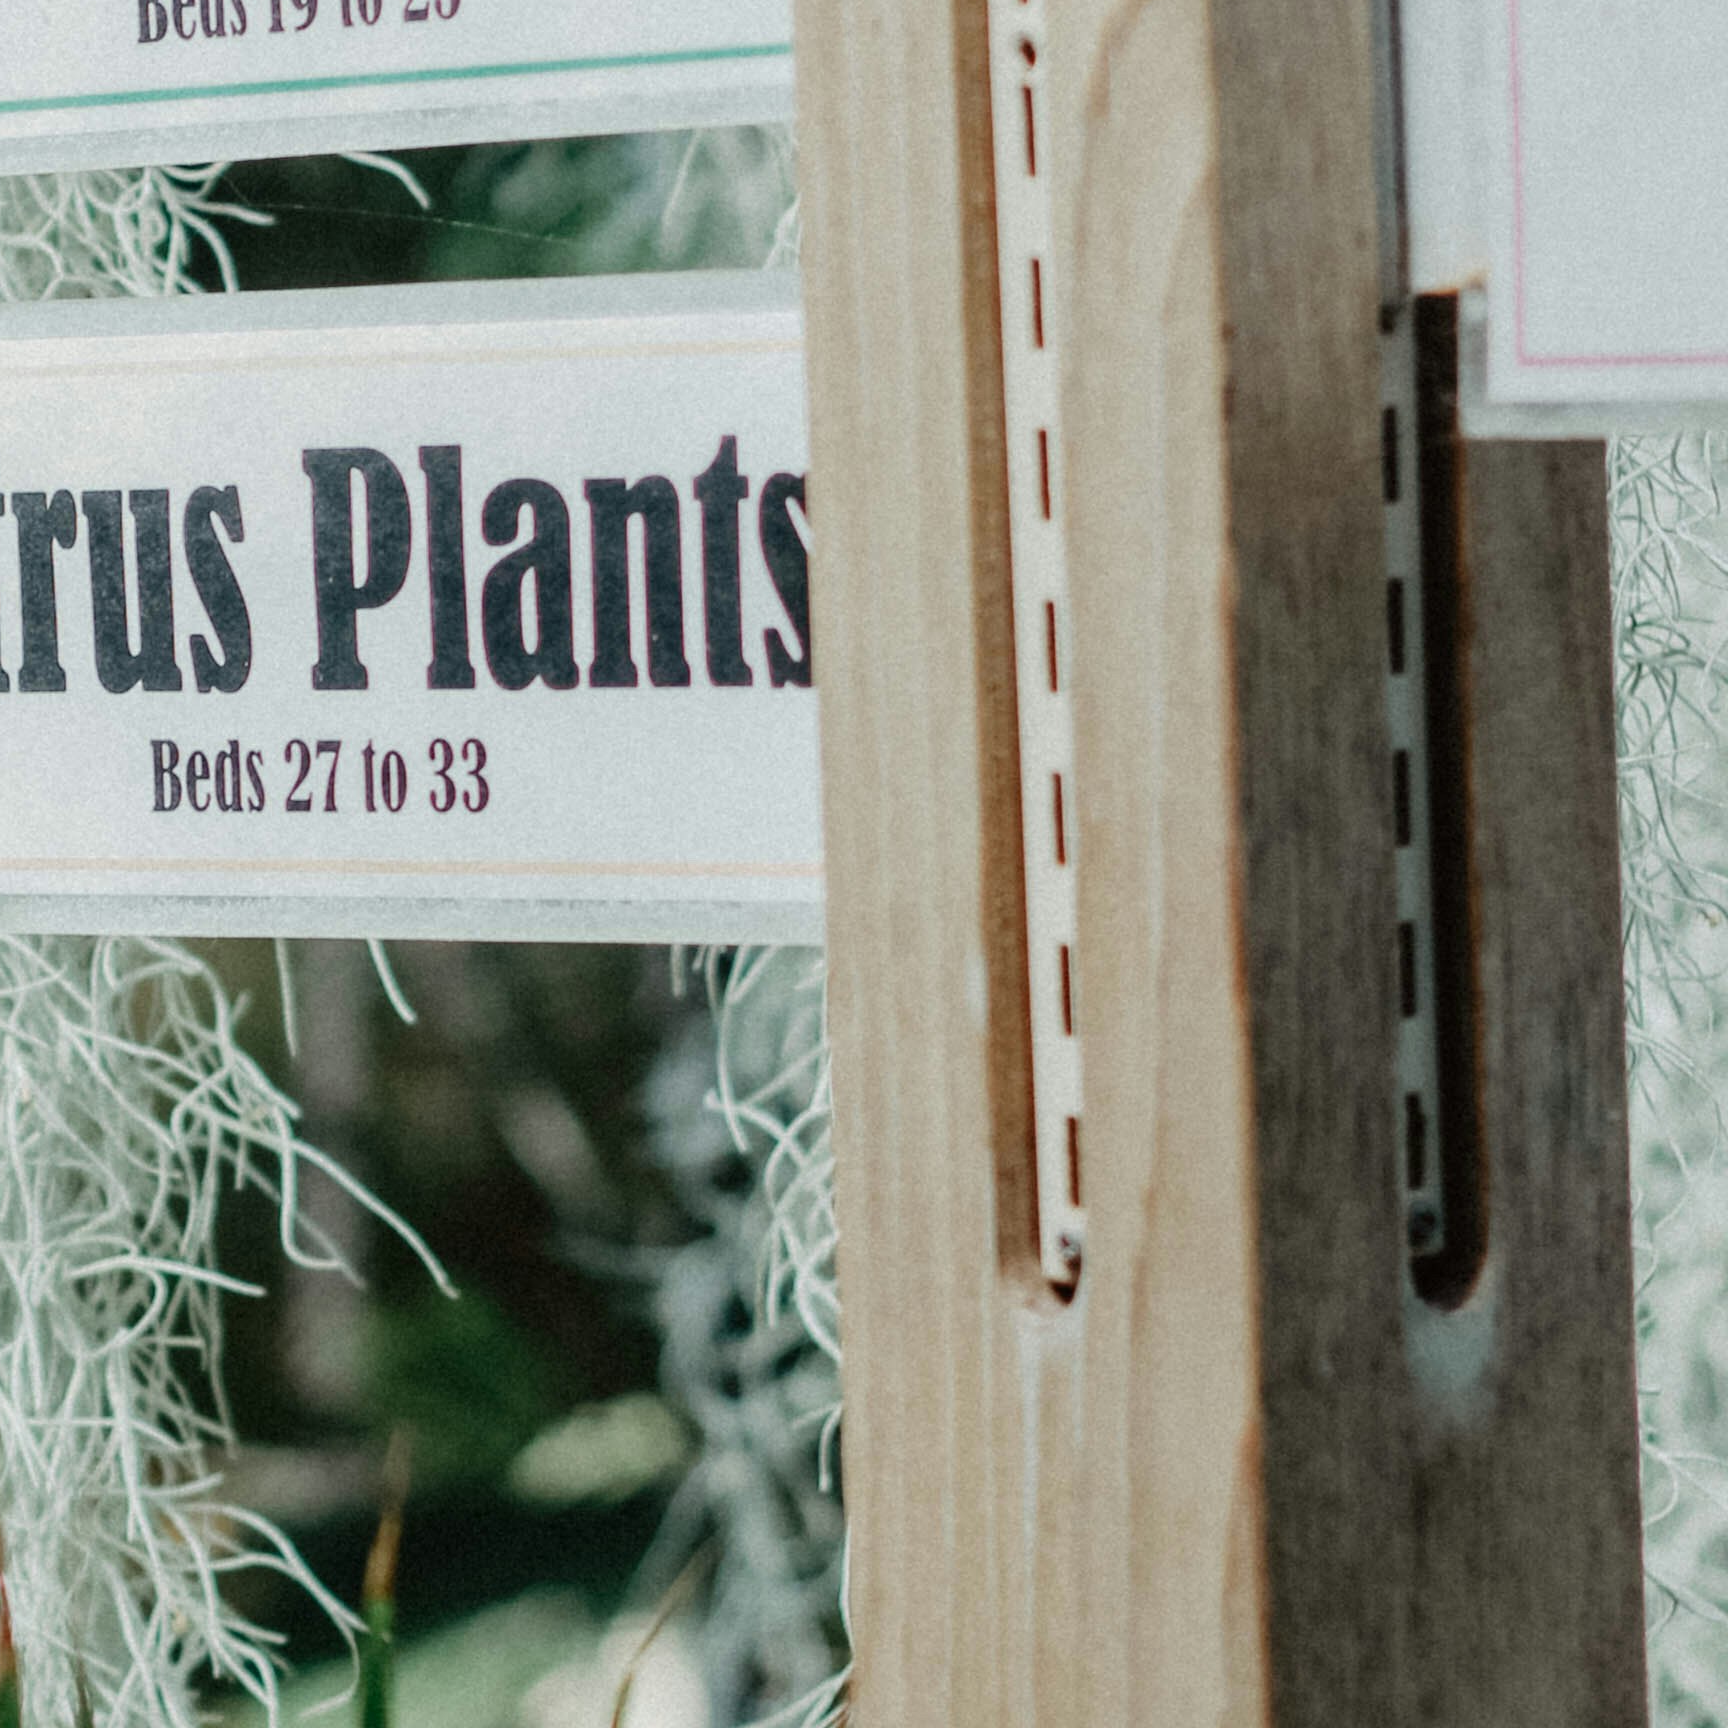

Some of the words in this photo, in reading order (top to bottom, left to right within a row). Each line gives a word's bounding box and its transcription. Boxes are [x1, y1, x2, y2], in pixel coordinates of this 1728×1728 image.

[302, 434, 813, 691] Plants
[151, 739, 266, 813] Beds
[284, 738, 342, 813] 27
[361, 740, 408, 813] to
[428, 737, 491, 813] 33
